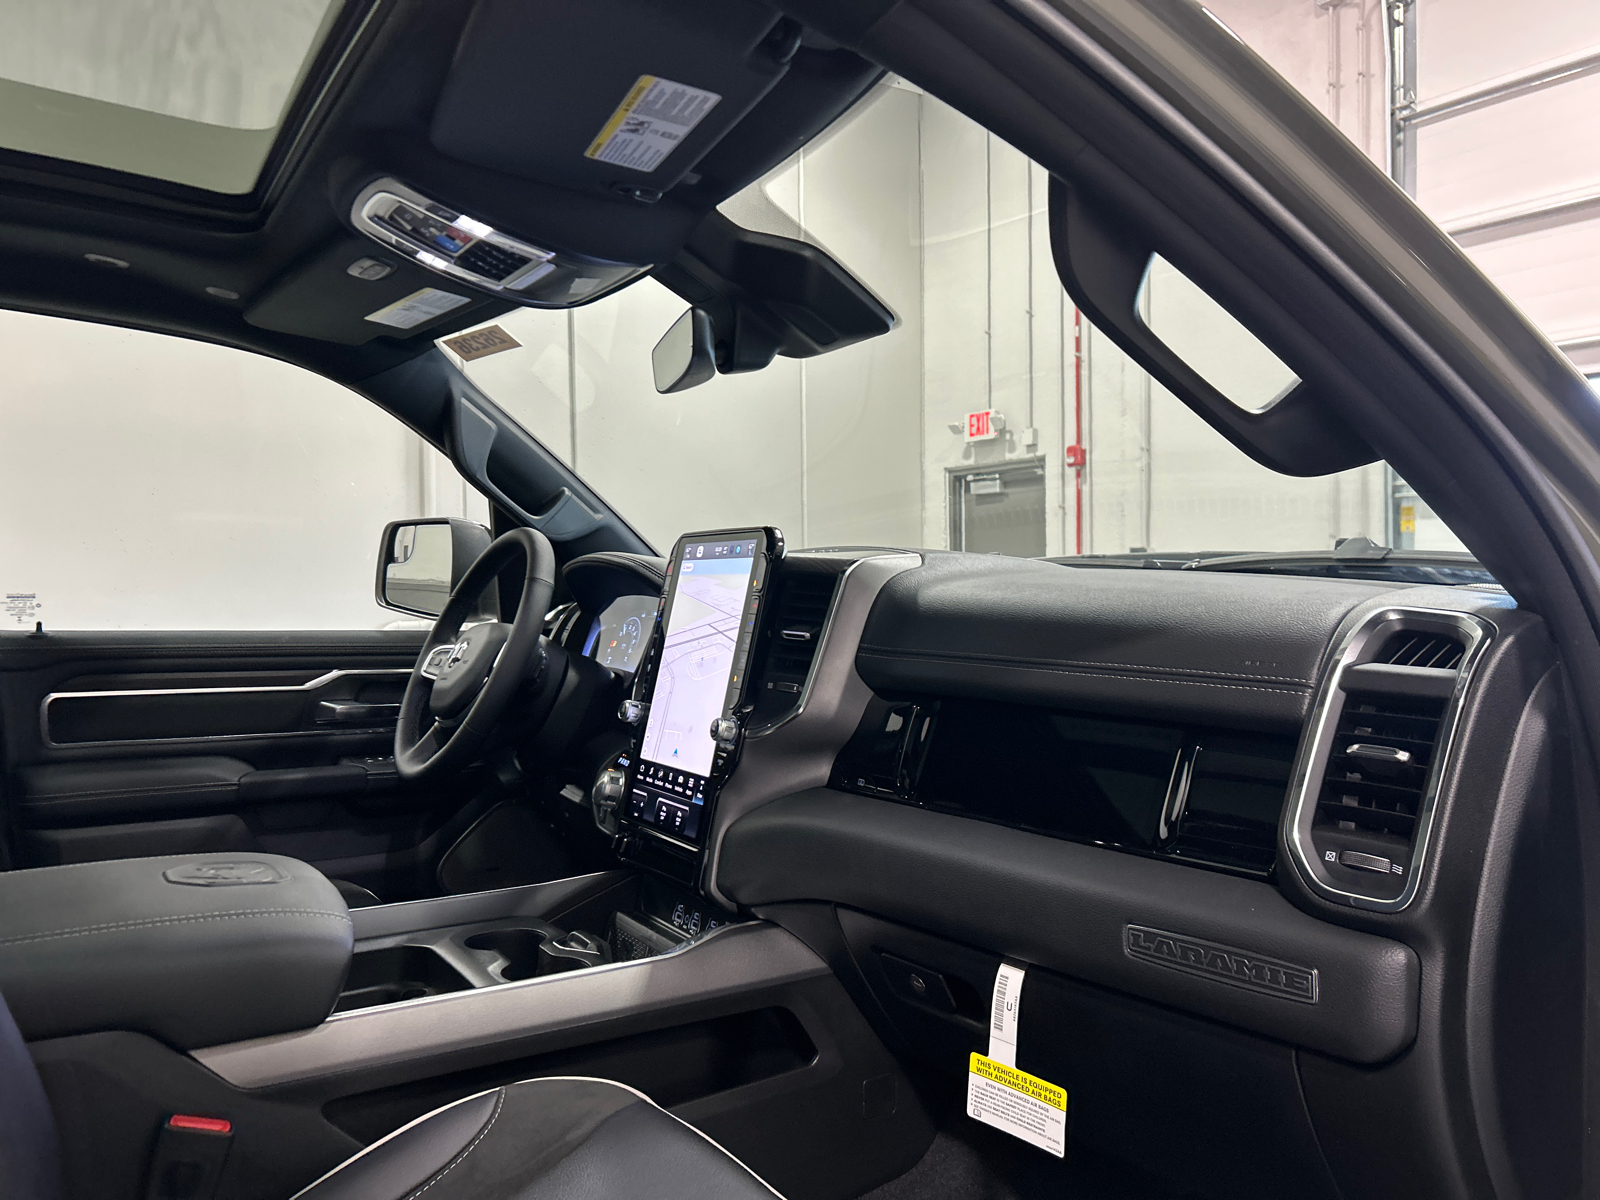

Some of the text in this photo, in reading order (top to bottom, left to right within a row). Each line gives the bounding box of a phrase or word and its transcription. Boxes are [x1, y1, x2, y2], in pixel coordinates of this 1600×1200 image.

[969, 411, 990, 437] EXIT
[1129, 930, 1312, 997] LARAMIE
[1006, 1001, 1012, 1012] U
[976, 1058, 991, 1069] THIS
[992, 1065, 1019, 1081] VEHICLE
[1029, 1080, 1061, 1099] EQUIPPED
[976, 1066, 1061, 1107] WITH ADVANCED AIR BAGS
[986, 1082, 995, 1090] EVEN
[997, 1087, 1006, 1095] WITH
[1008, 1091, 1029, 1104] ADVANCED
[1038, 1104, 1048, 1113] BAGS
